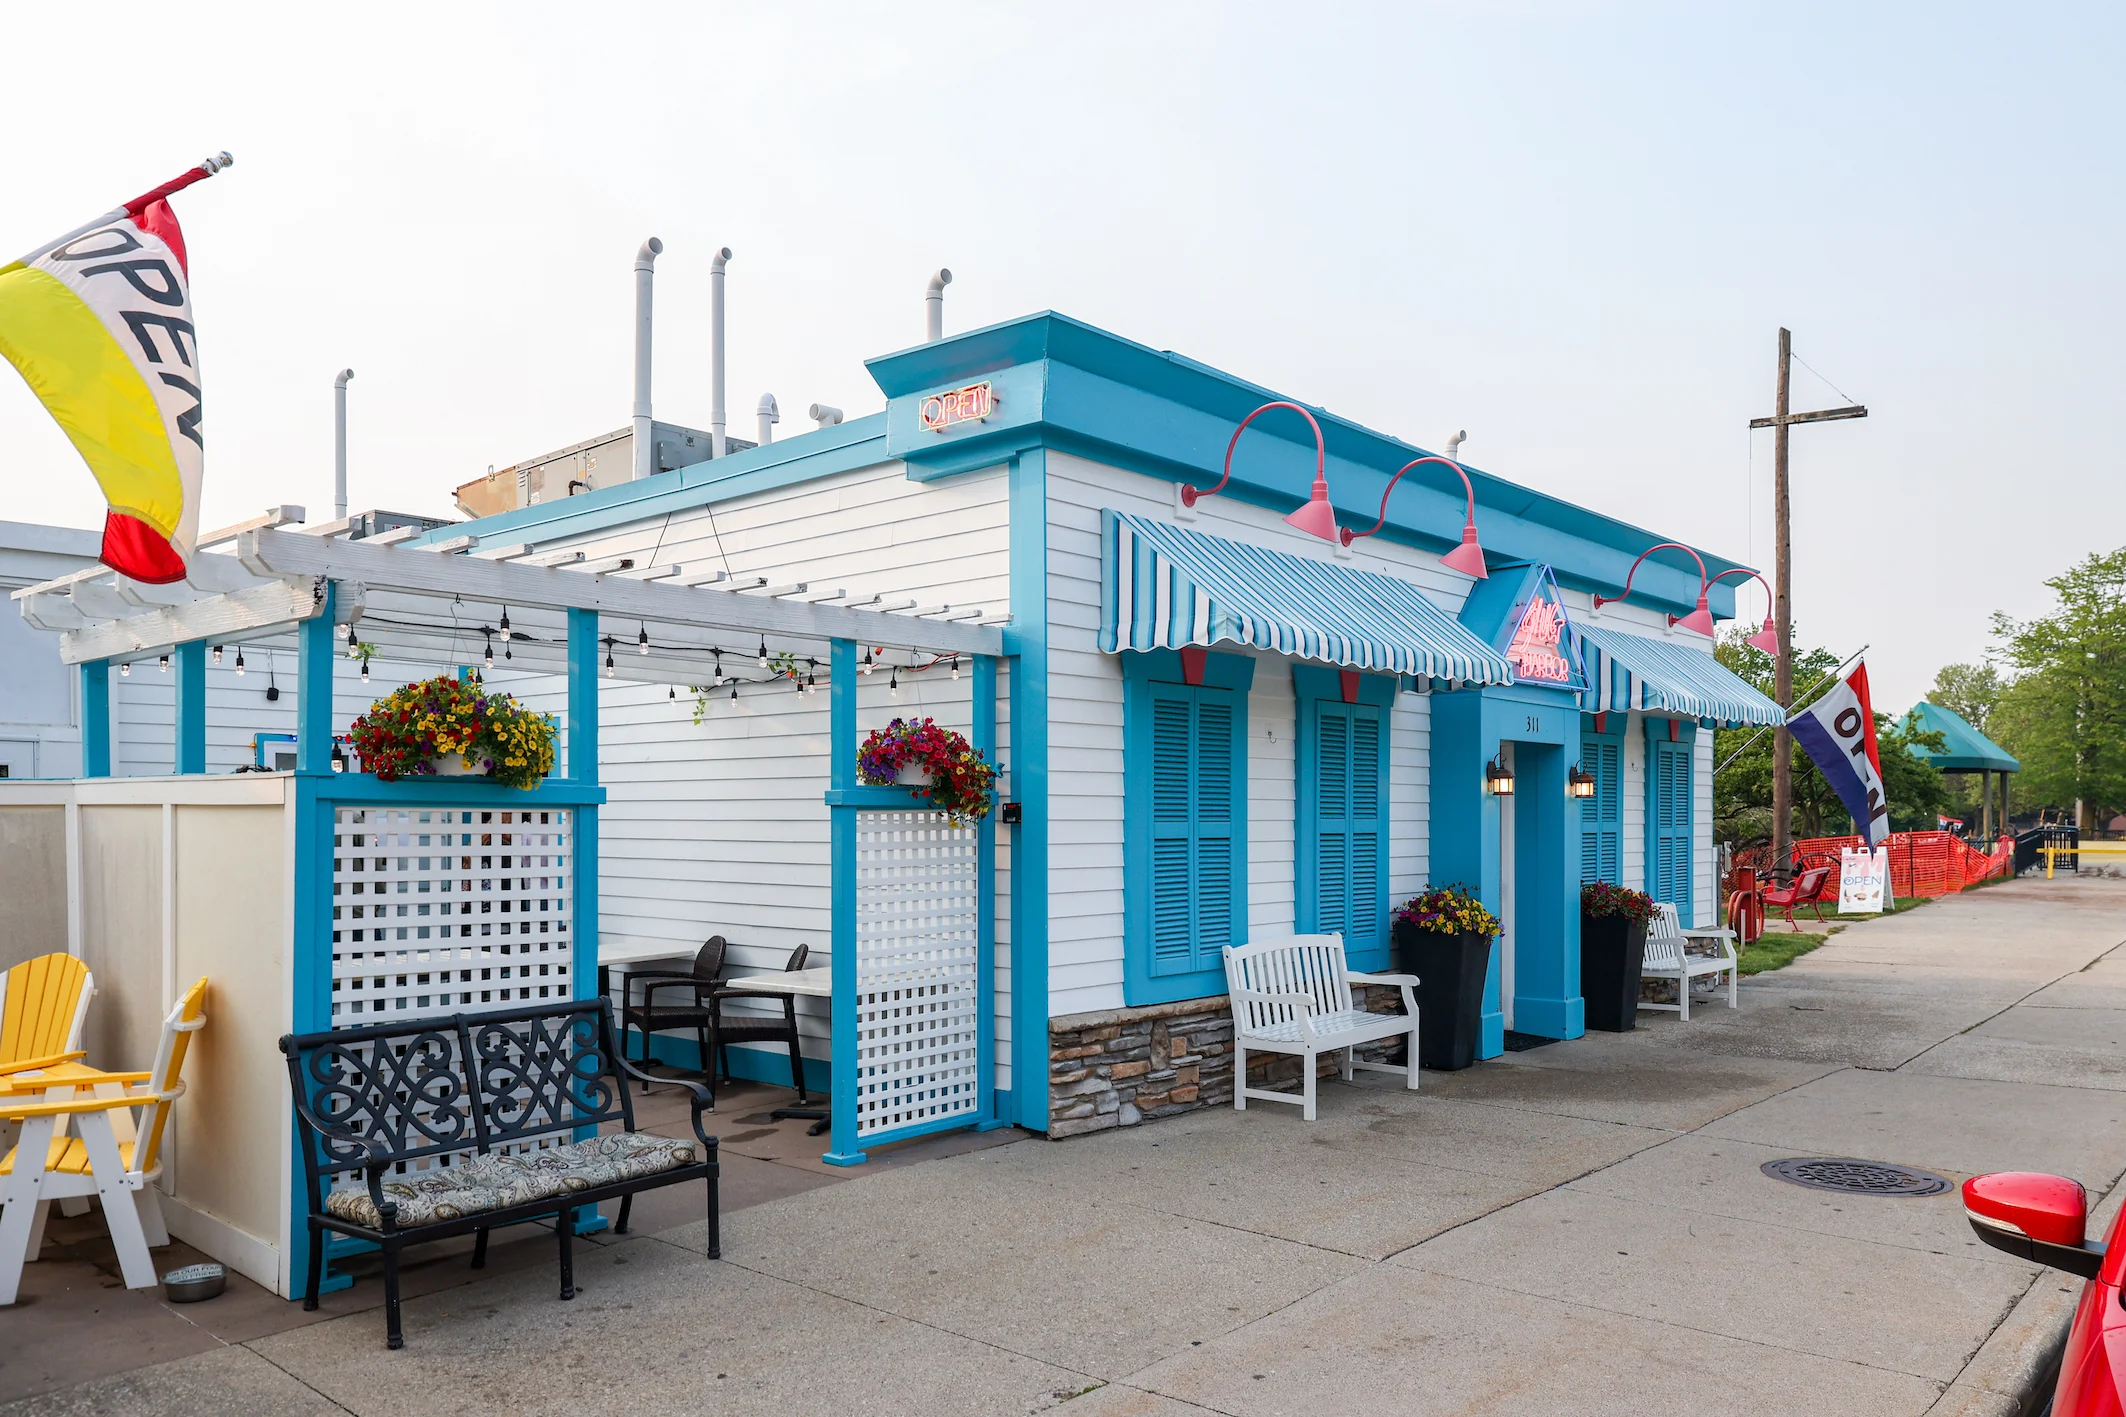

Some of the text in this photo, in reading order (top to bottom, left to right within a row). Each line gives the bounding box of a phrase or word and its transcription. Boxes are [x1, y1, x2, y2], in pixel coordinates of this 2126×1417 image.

[51, 228, 204, 453] OPEN
[922, 386, 991, 428] OPEN
[1520, 652, 1569, 682] HARBOR
[1526, 715, 1539, 732] 311
[1833, 707, 1888, 823] ON
[1843, 875, 1882, 886] OPEN
